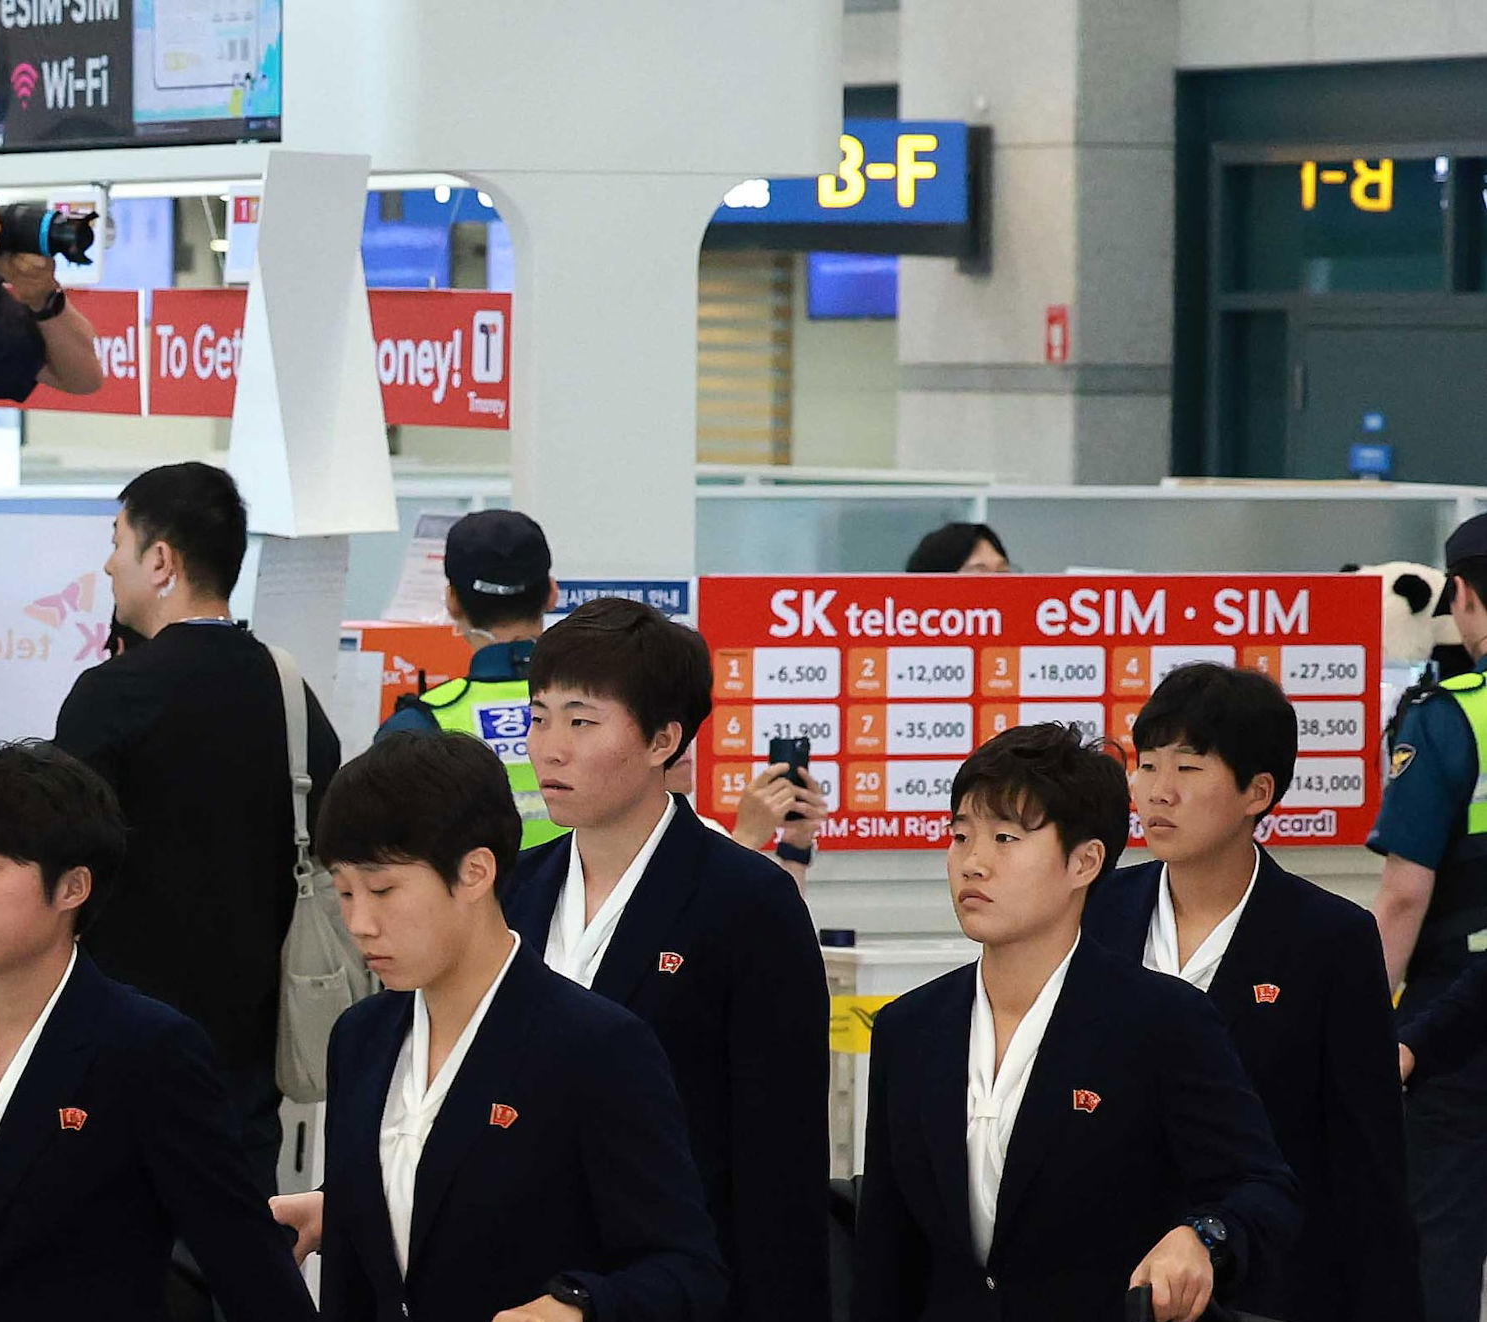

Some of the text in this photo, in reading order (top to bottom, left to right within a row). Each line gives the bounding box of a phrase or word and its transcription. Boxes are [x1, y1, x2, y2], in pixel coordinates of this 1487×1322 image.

[40, 55, 110, 110] Wi-Fi
[156, 325, 187, 377] To
[376, 329, 463, 403] oney!
[769, 589, 838, 638] SK
[844, 596, 1003, 637] telecom
[1035, 588, 1168, 636] eSIM
[1212, 588, 1311, 636] SIM
[728, 658, 740, 679] 1
[861, 657, 876, 678] 2
[994, 656, 1008, 677] 3
[1125, 656, 1139, 676] 4
[726, 716, 741, 734] 6
[861, 714, 876, 734] 7
[722, 773, 745, 792] 15
[855, 772, 880, 791] 20
[1278, 810, 1335, 836] card!
